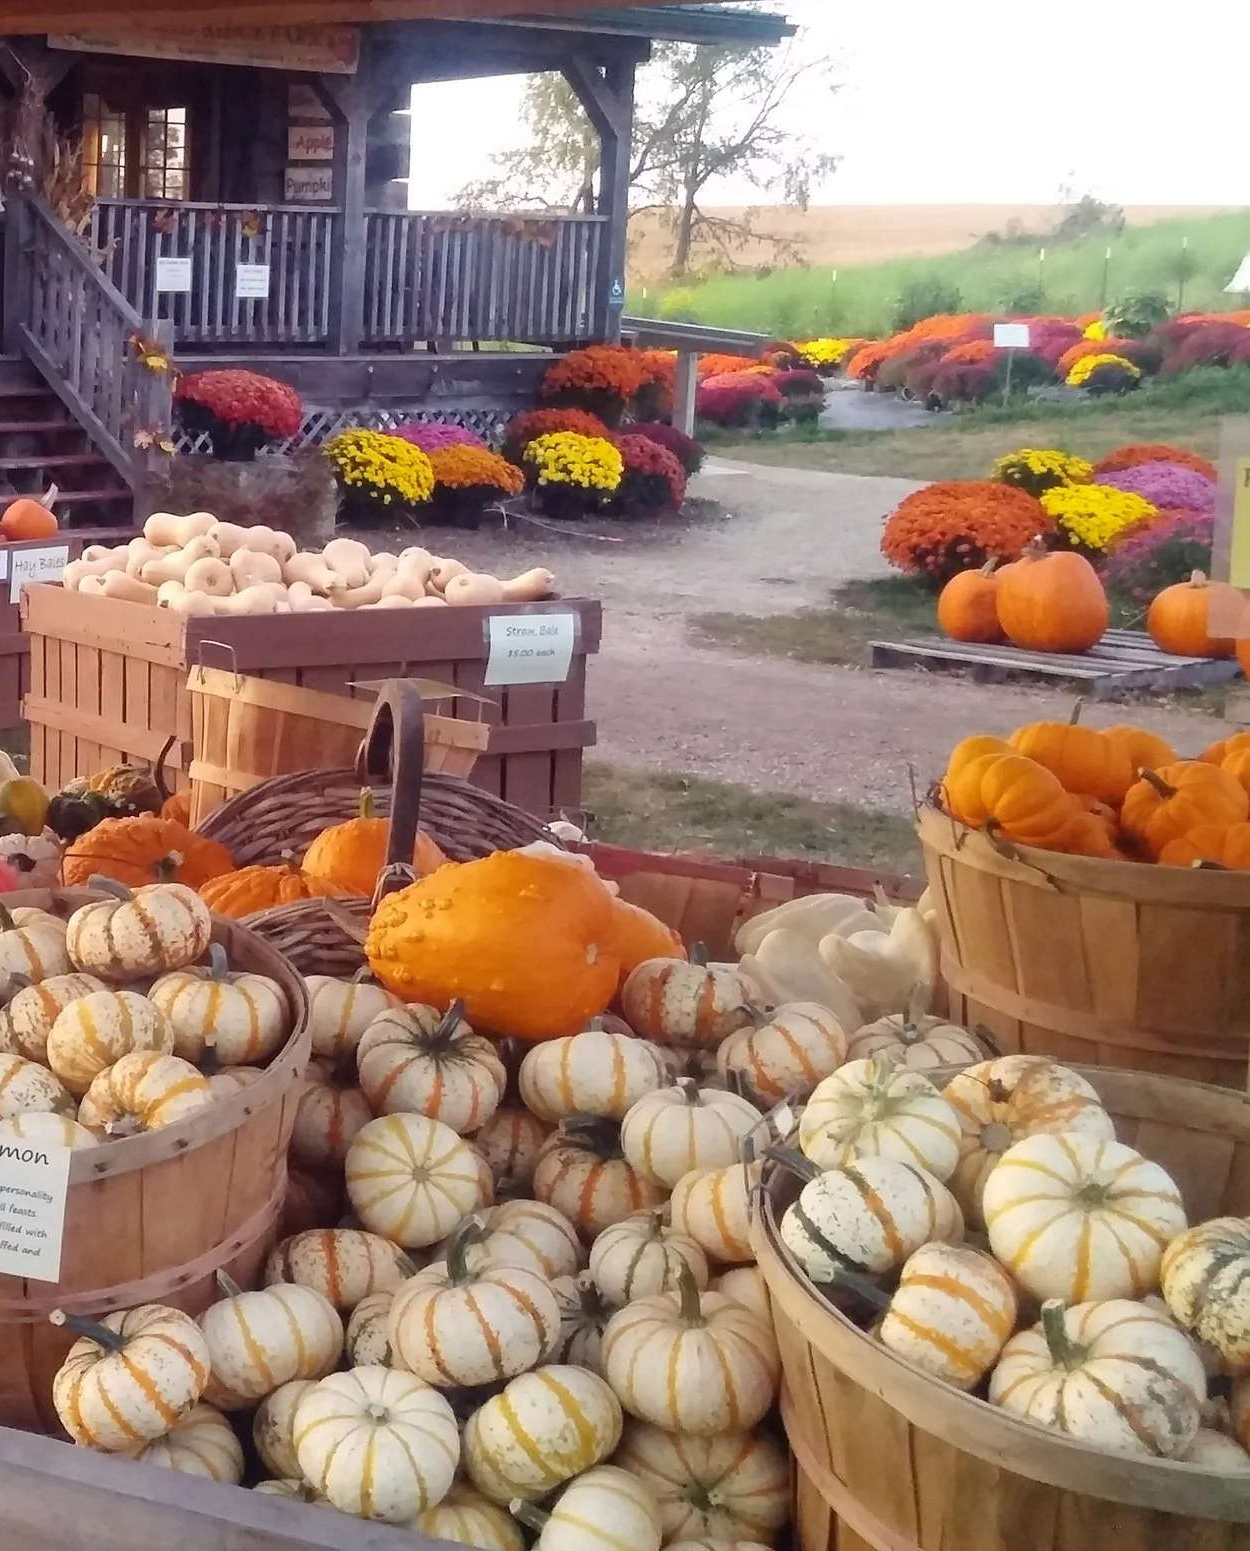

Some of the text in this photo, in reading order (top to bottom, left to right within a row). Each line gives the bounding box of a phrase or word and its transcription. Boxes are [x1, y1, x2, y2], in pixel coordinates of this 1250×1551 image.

[286, 177, 331, 197] Pumpki
[14, 560, 36, 578] Hay
[506, 626, 535, 637] Straw
[536, 648, 555, 657] each
[0, 1185, 53, 1204] personality
[25, 1228, 48, 1239] with
[21, 1248, 41, 1257] and
